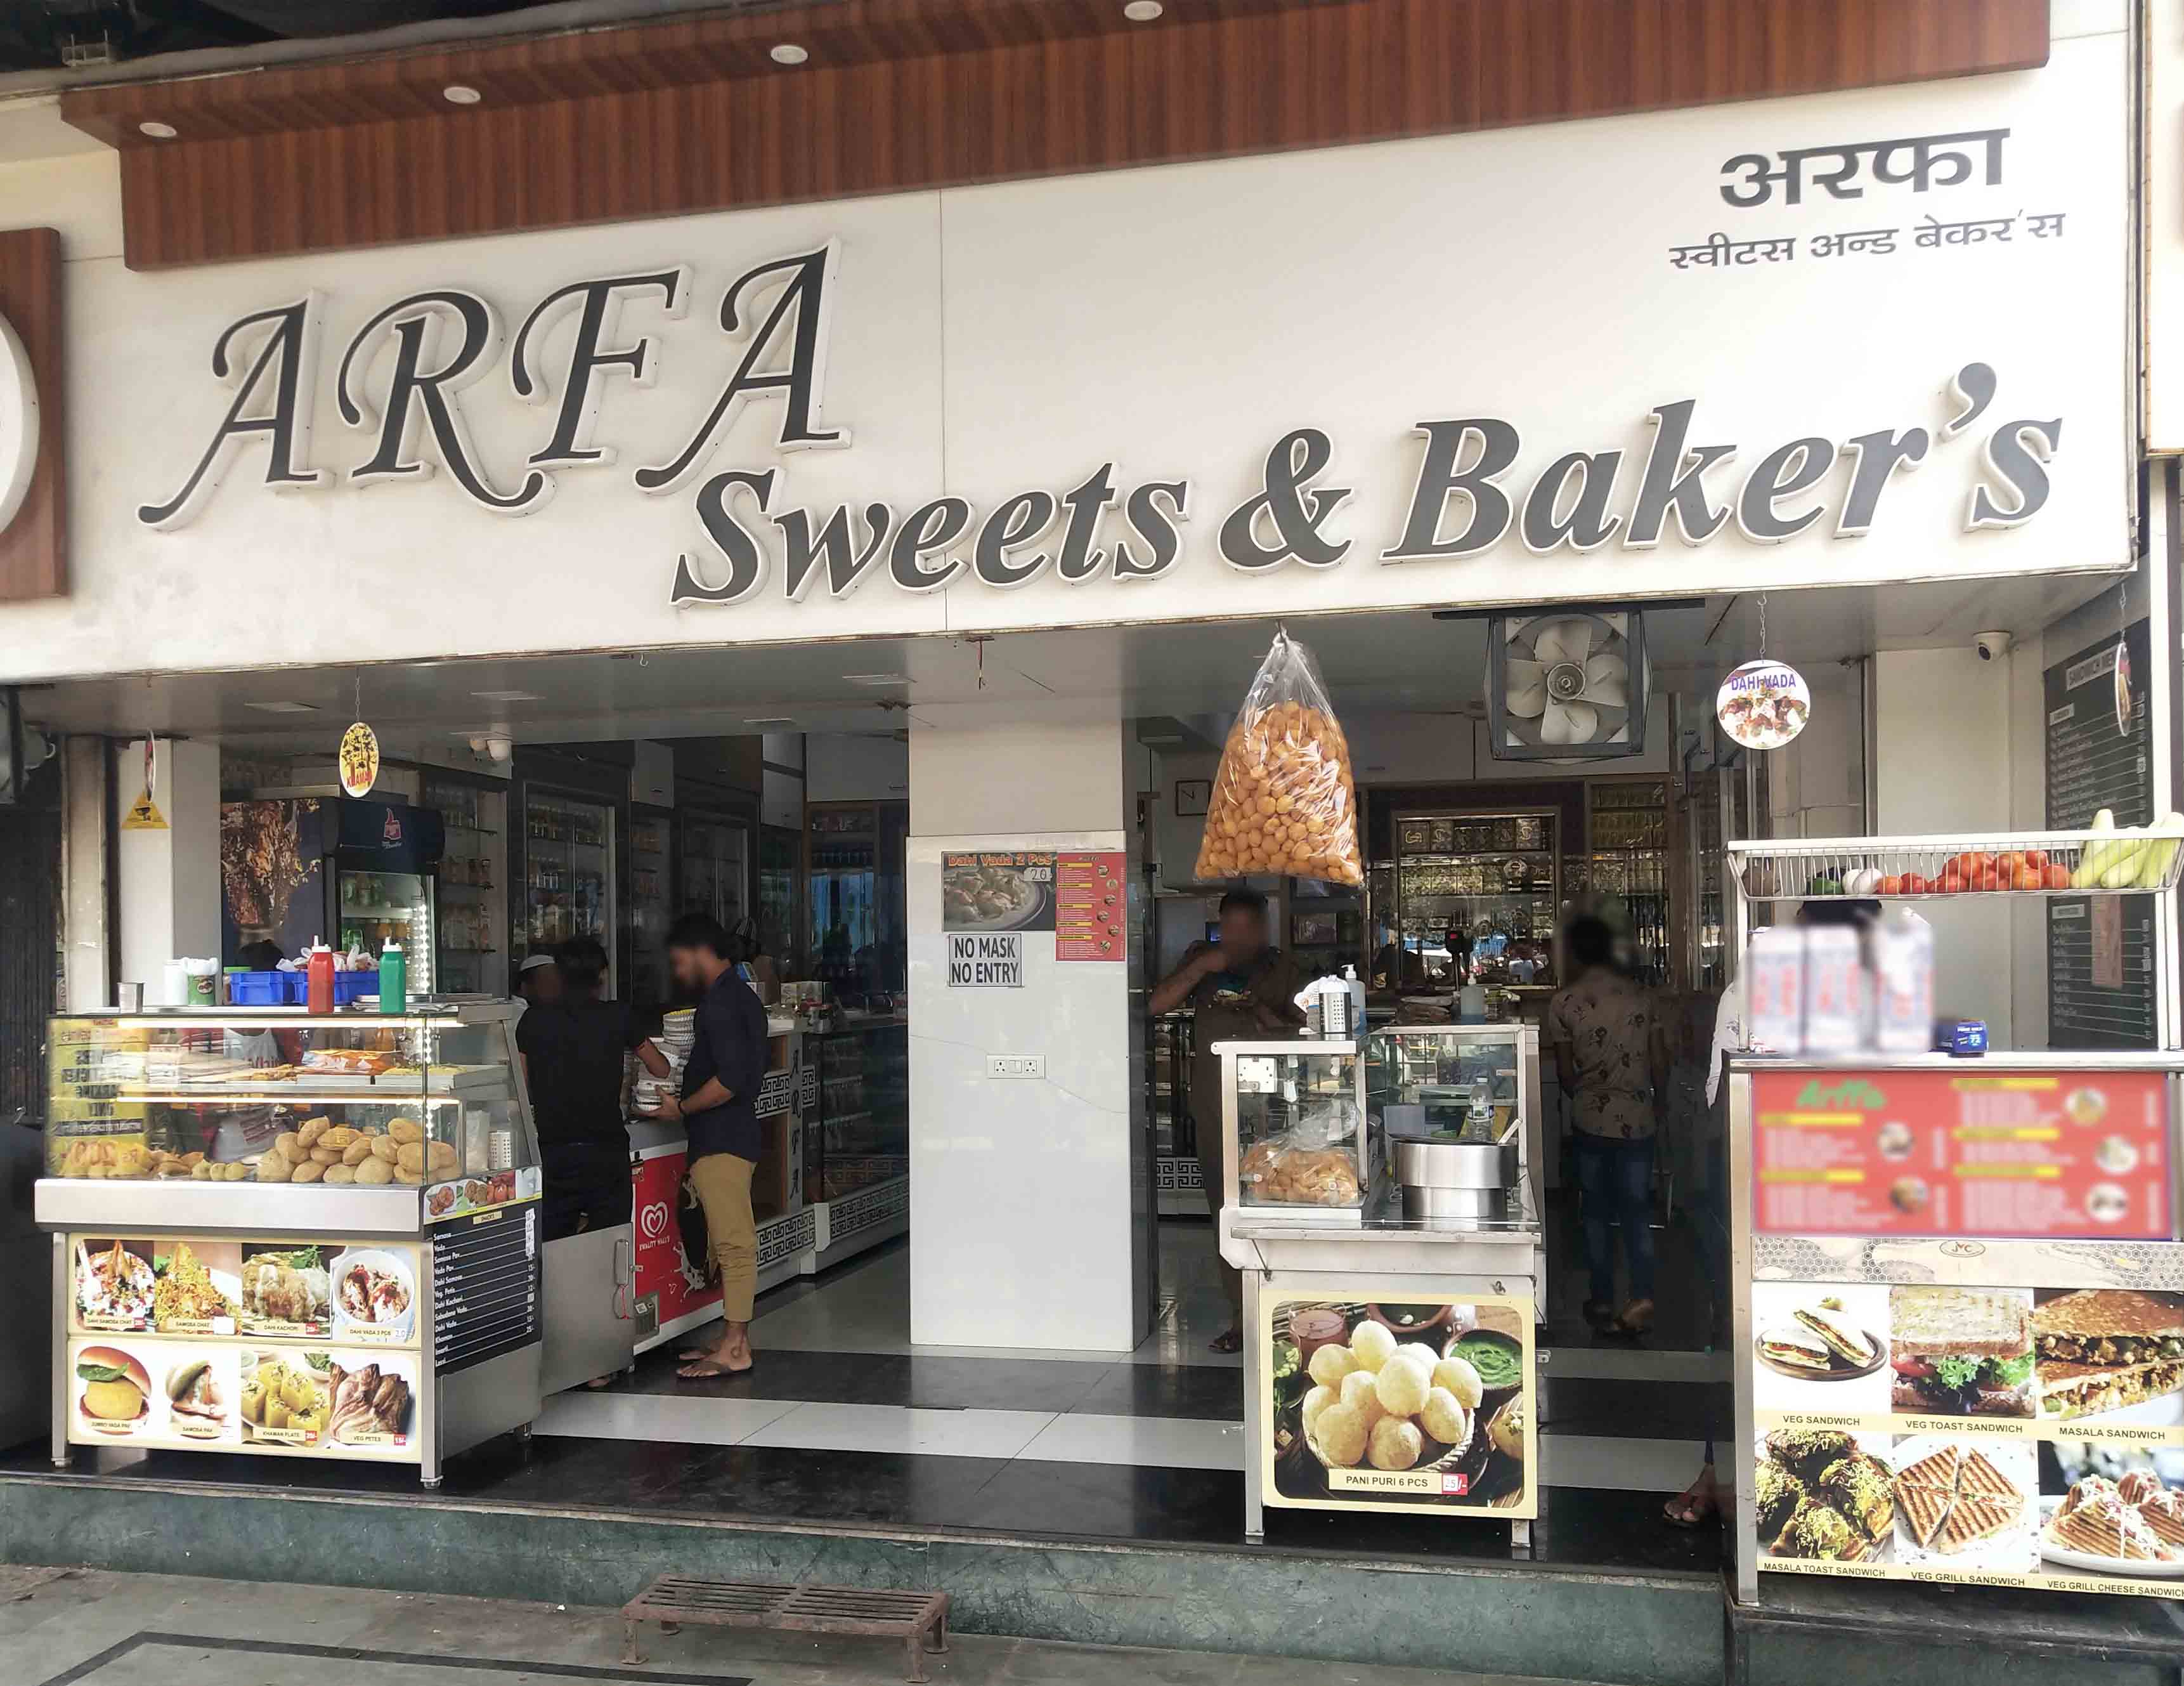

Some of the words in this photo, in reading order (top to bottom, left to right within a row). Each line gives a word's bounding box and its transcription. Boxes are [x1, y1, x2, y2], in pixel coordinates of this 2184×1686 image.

[1719, 127, 2011, 209] अरफा
[1669, 232, 1796, 270] स्वीटस
[1811, 228, 1900, 258] अन्ड
[138, 242, 847, 526] ARFA
[670, 461, 1189, 606] Sweets
[1218, 426, 1355, 572] &
[1379, 362, 2062, 565] Baker's
[1731, 676, 1760, 691] DAHI
[1764, 674, 1797, 688] VADA
[948, 853, 977, 866] Dahi
[981, 853, 1013, 866] Vada
[1015, 854, 1025, 866] 2
[1028, 853, 1053, 866] Pcs
[954, 938, 975, 958] NO
[979, 938, 1016, 958] MASK
[952, 964, 972, 984] NO
[976, 962, 1019, 983] ENTRY
[1783, 1415, 1805, 1425] VEG
[1807, 1415, 1861, 1427] SANDWICH
[1906, 1420, 1927, 1430] VEG
[1929, 1420, 1961, 1432] TOAST
[1965, 1421, 2023, 1434] SANDWICH
[2058, 1427, 2105, 1439] MASALA
[2107, 1428, 2166, 1440] SANDWICH
[1345, 1475, 1370, 1486] PANI
[1372, 1476, 1396, 1487] PURI
[1398, 1477, 1405, 1487] 6
[1407, 1477, 1429, 1487] PCS
[1764, 1562, 1802, 1574] MASALA
[1802, 1564, 1833, 1574] TOAST
[1836, 1565, 1886, 1578] SANDWICH
[1911, 1571, 1932, 1581] VEG
[1934, 1572, 1966, 1583] GRILL
[1968, 1574, 2025, 1587] SANDWICH
[2047, 1579, 2067, 1590] VEG
[2069, 1580, 2096, 1591] GRILL
[2097, 1582, 2135, 1594] CHEESE
